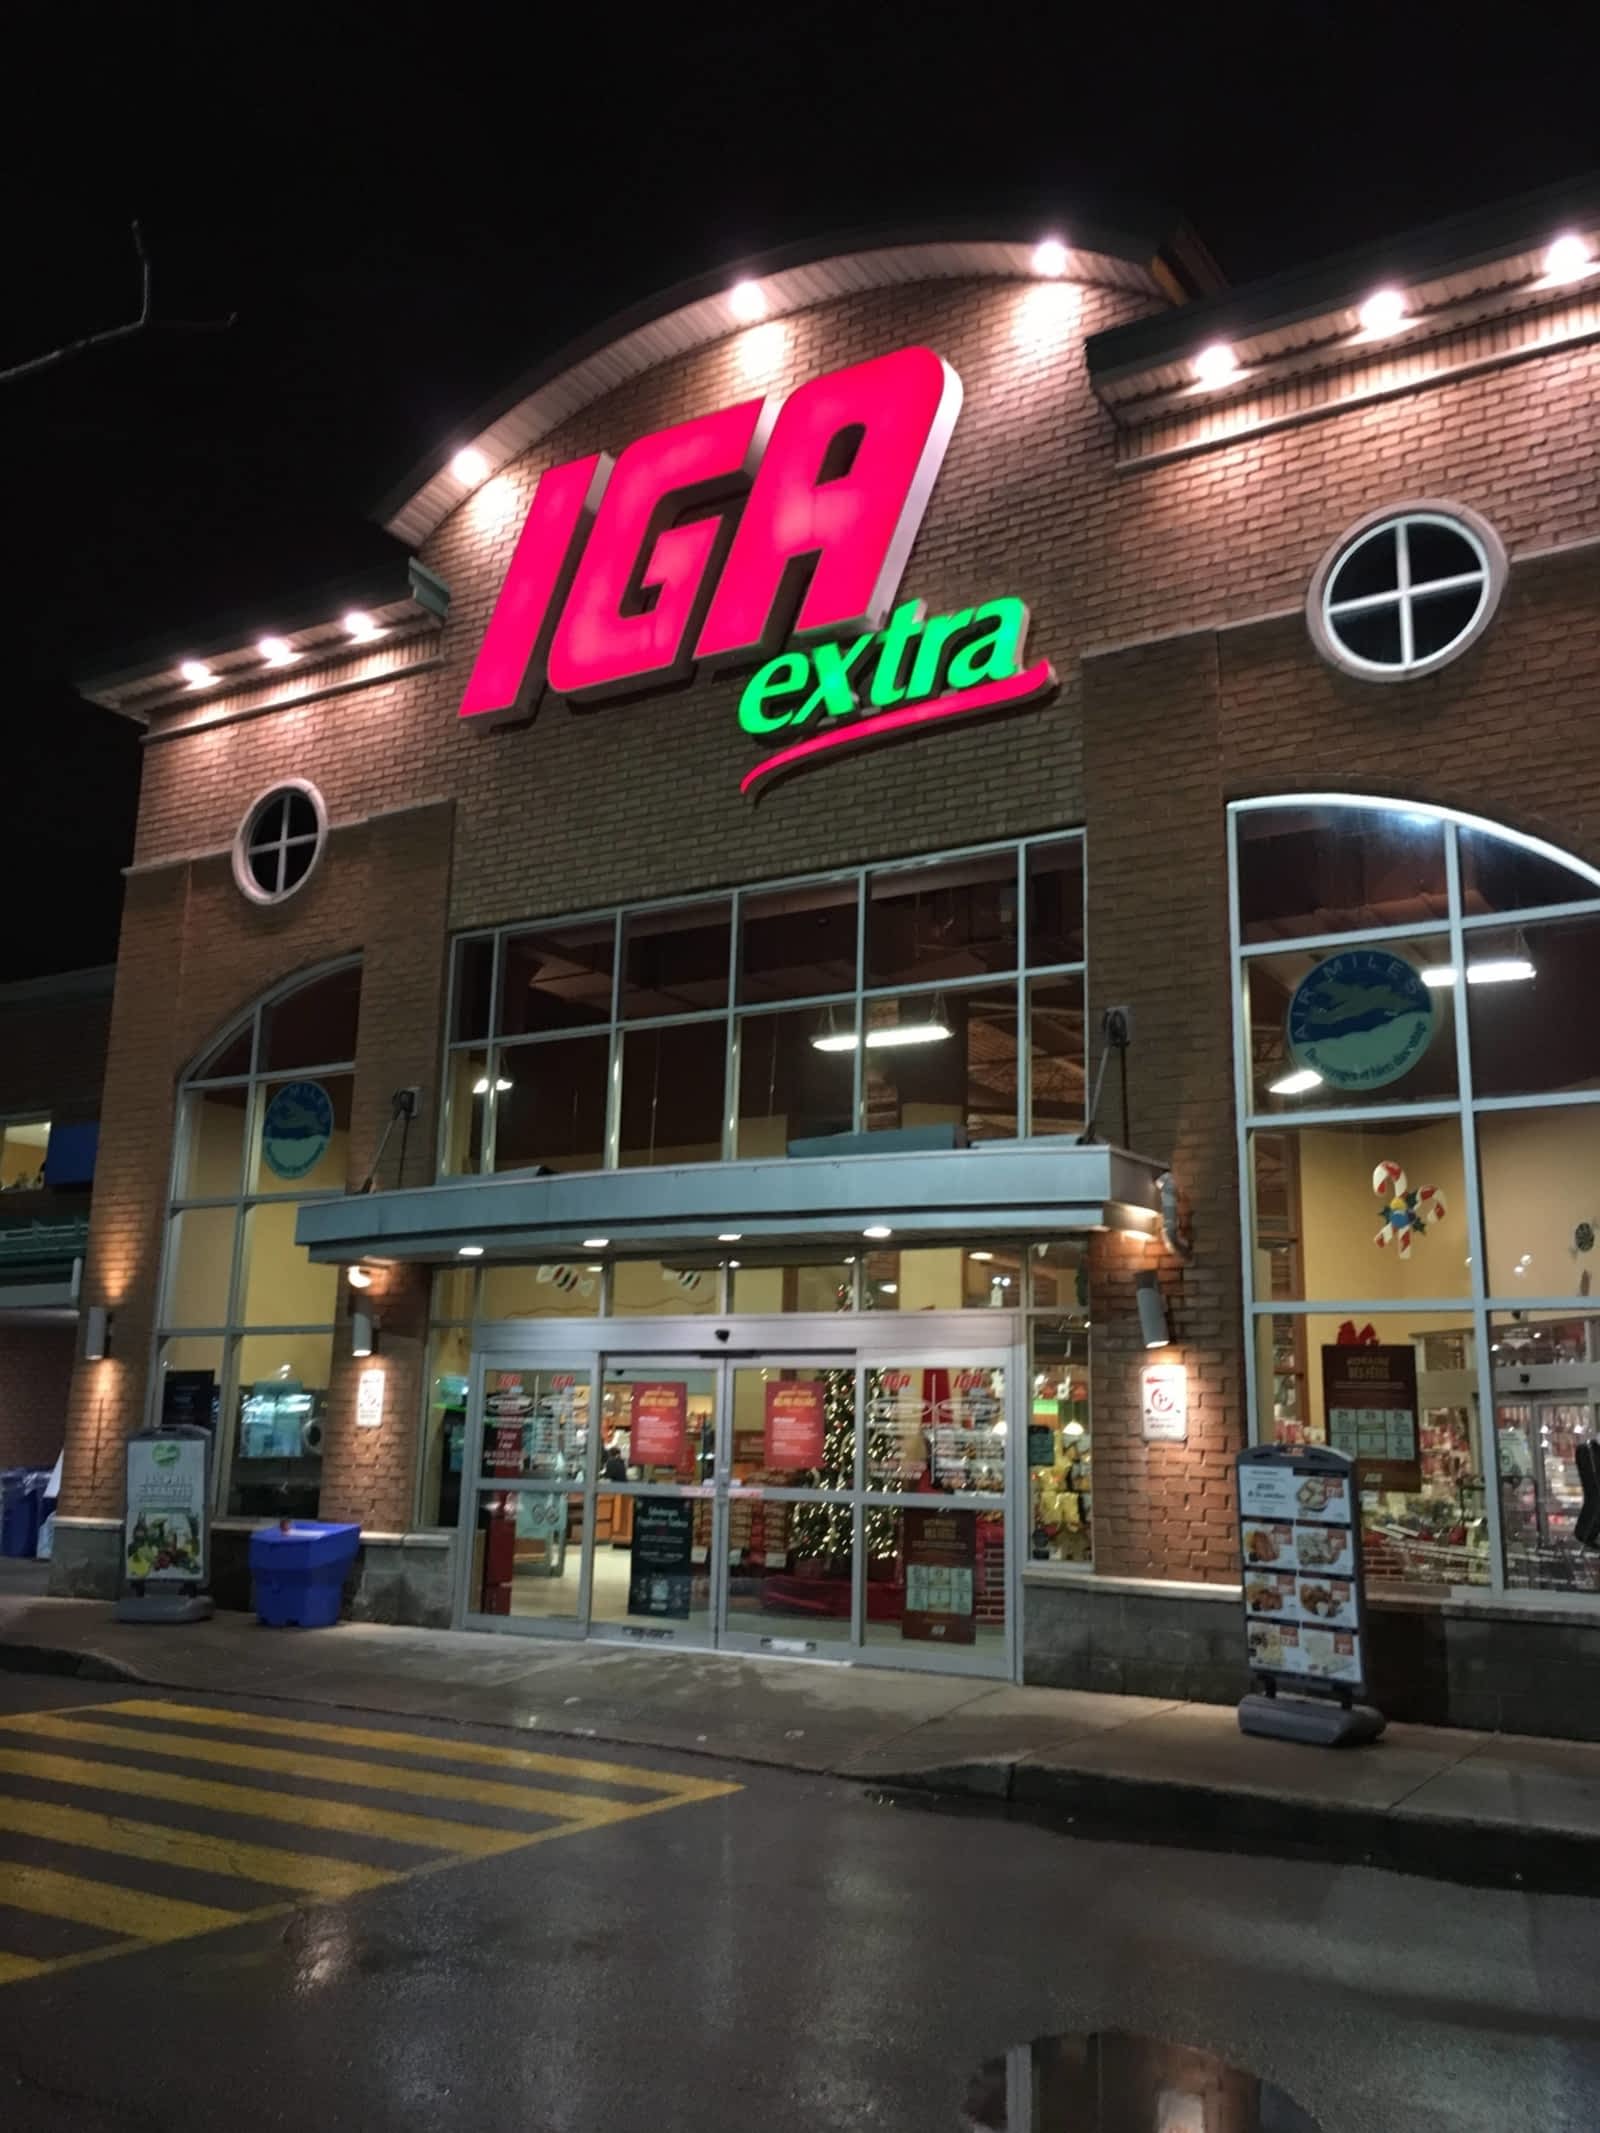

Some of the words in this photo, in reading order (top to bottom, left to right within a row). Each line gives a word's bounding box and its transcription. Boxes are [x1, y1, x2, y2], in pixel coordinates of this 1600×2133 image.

[458, 345, 950, 718] IGA
[738, 597, 1027, 735] extra
[1294, 987, 1315, 1039] AIR
[1322, 954, 1418, 996] MILES
[954, 1373, 984, 1389] IGA
